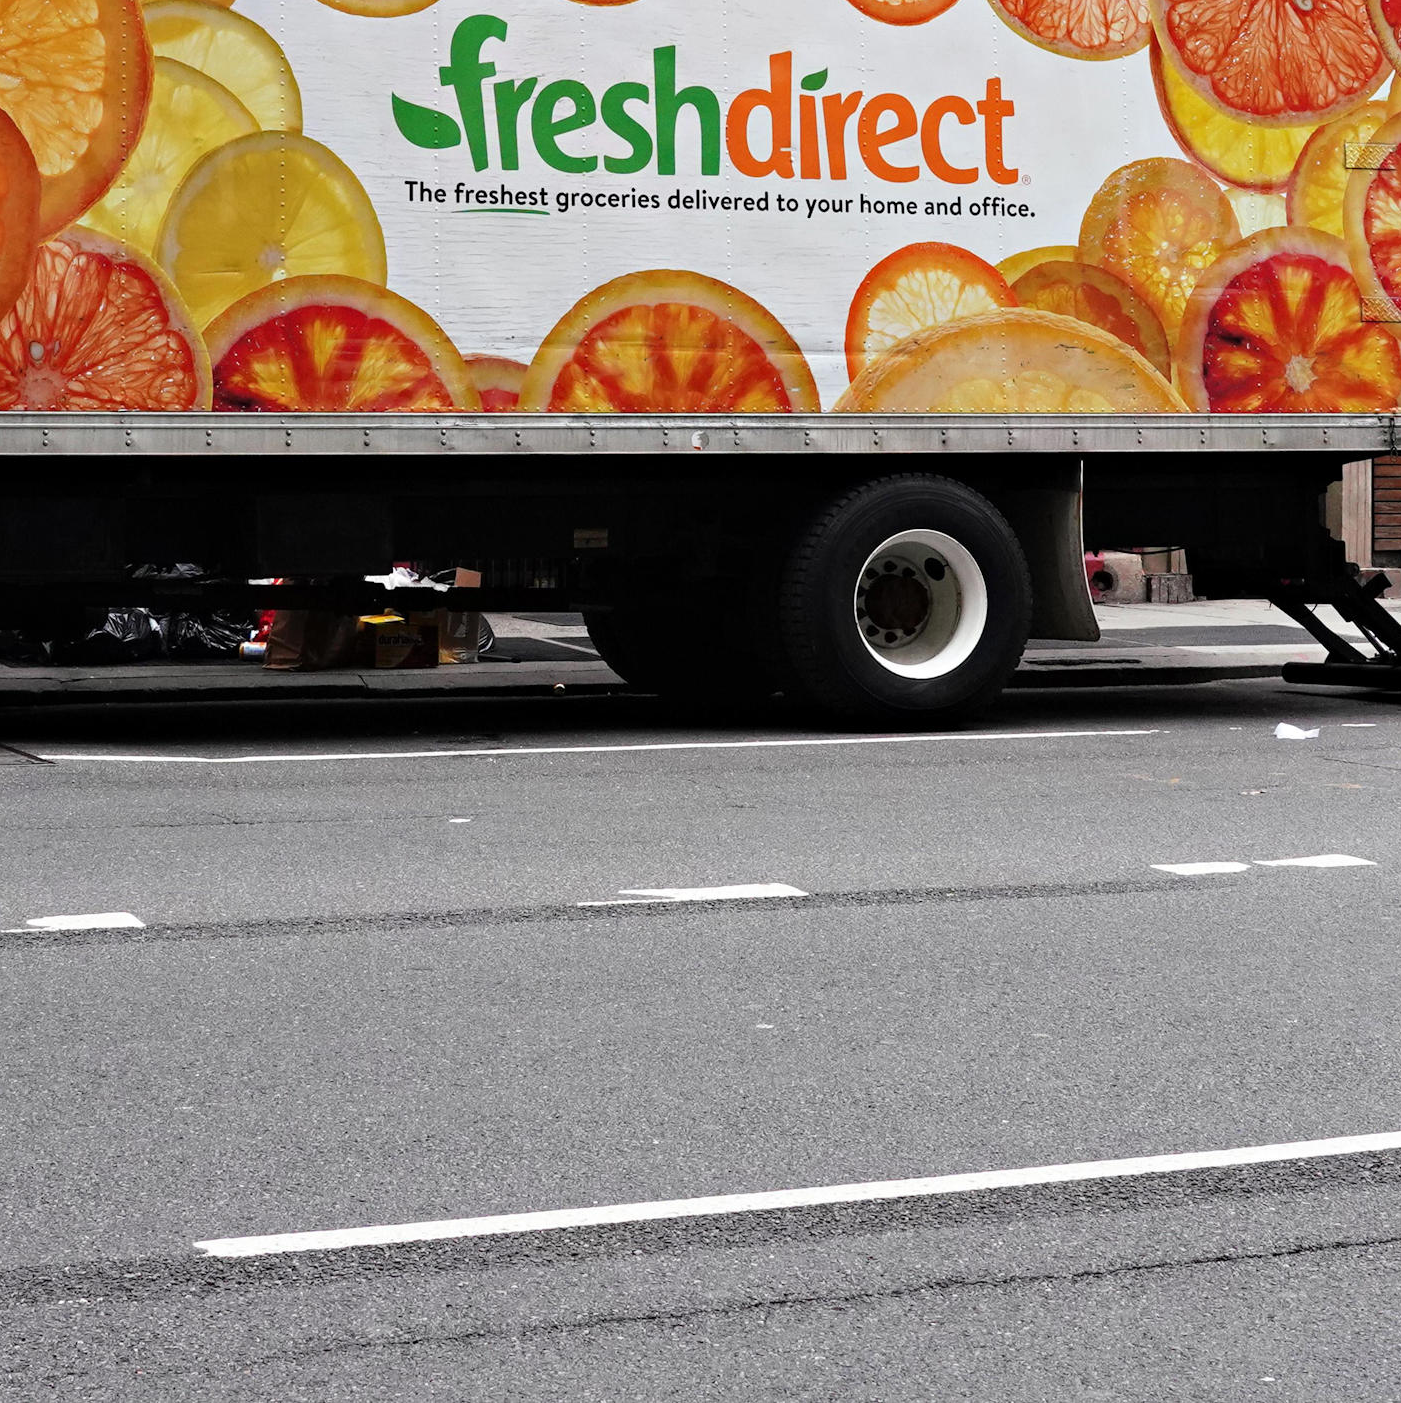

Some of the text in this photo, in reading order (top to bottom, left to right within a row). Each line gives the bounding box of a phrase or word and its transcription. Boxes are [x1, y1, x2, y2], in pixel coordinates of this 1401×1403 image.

[405, 181, 1036, 218] The freshest groceries delivered to your home and office.
